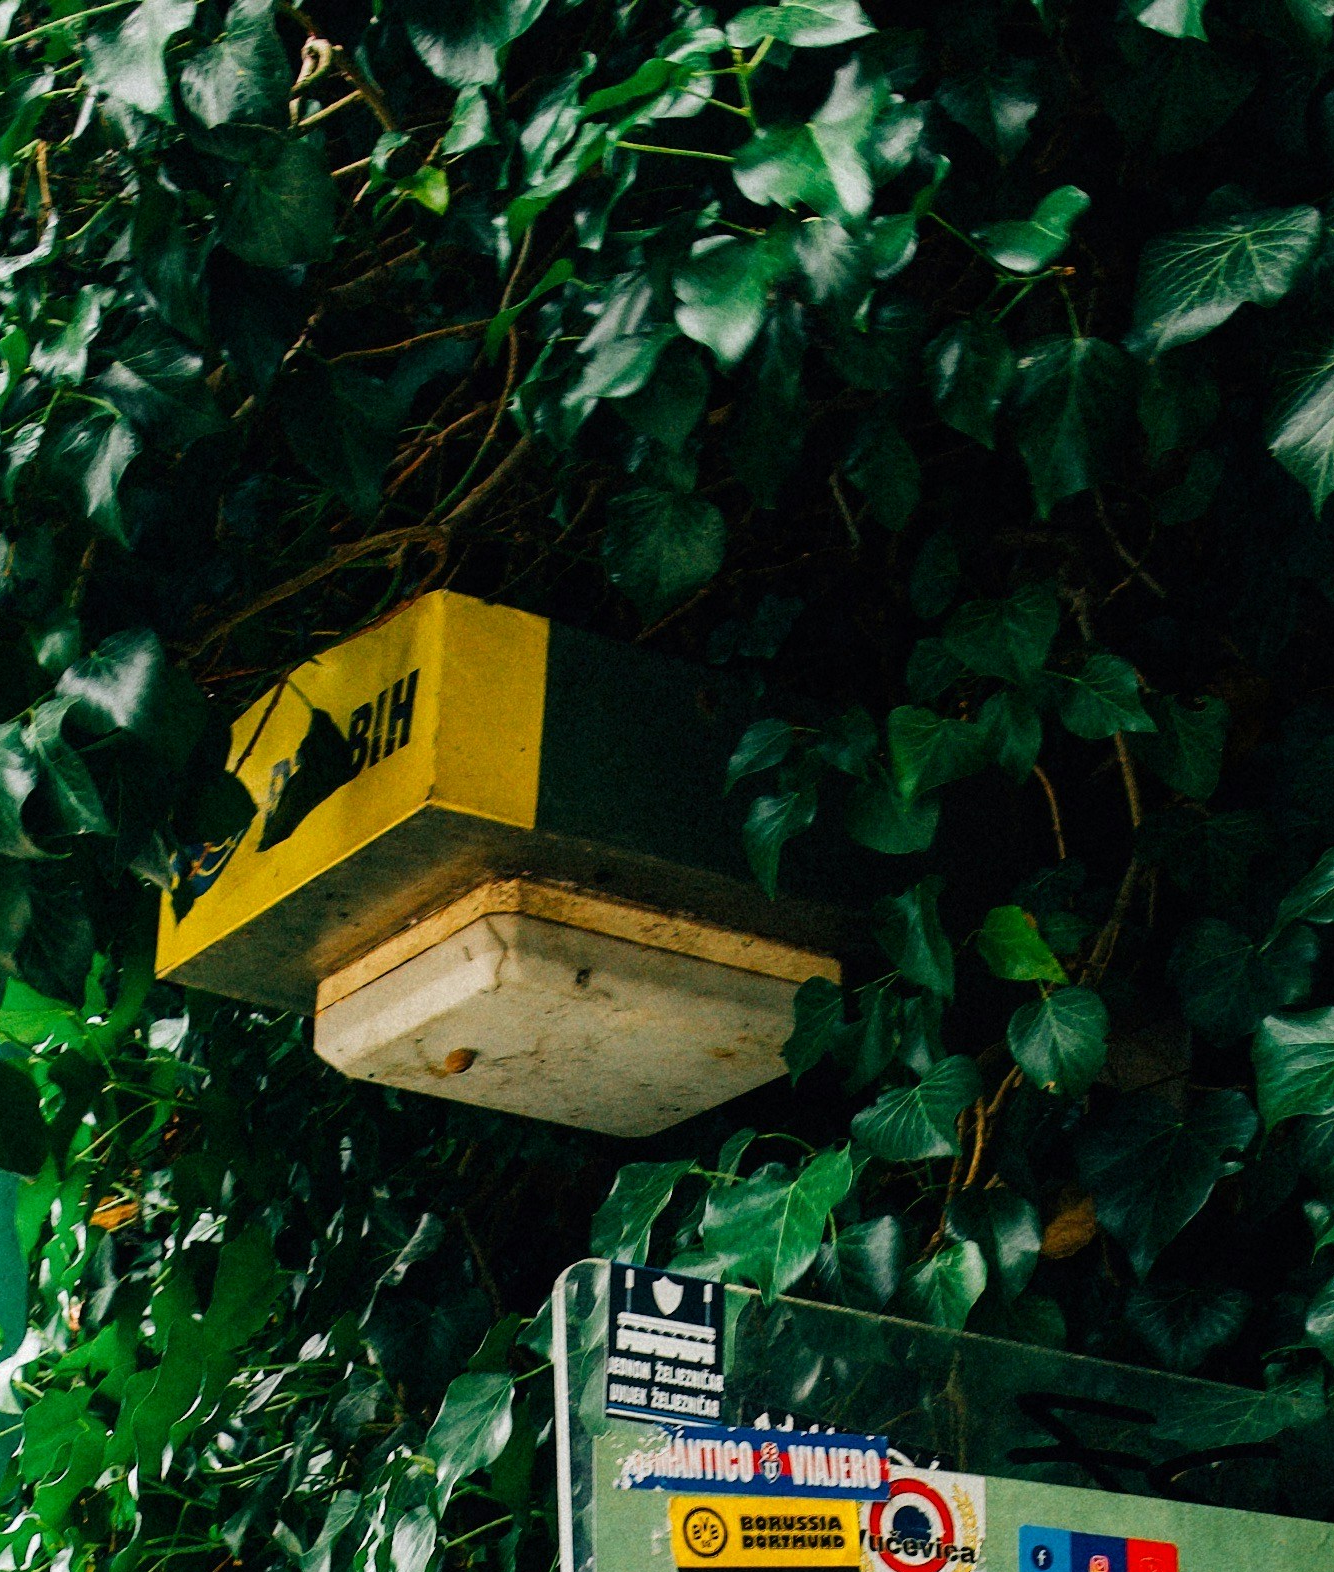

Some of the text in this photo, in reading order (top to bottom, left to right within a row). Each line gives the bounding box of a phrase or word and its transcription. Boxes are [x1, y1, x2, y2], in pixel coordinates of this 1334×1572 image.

[787, 1445, 882, 1490] VIAJERO
[740, 1515, 842, 1531] BORUSSIA
[742, 1534, 846, 1550] DORTMUND
